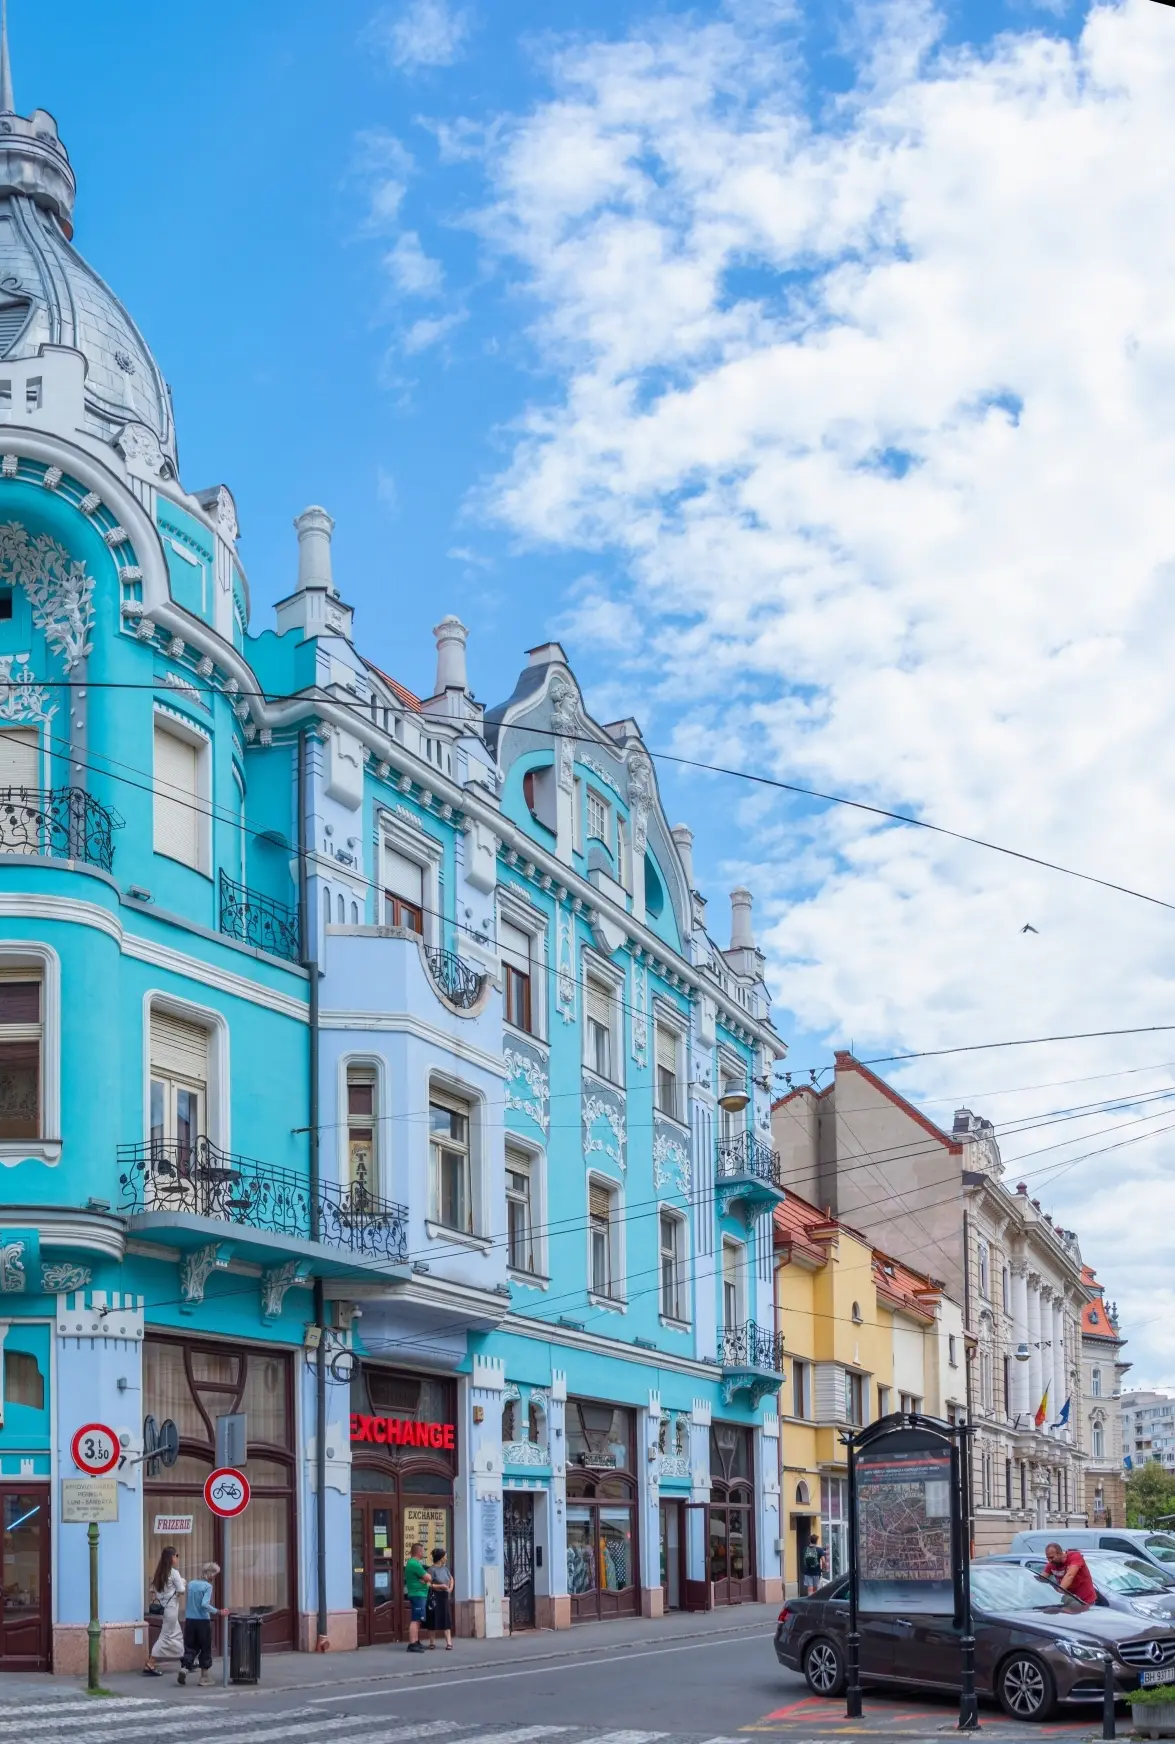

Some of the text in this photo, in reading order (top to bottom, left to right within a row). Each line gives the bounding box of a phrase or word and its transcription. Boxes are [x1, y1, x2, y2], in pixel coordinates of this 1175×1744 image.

[349, 1412, 455, 1449] EXCHANGE
[407, 1510, 443, 1521] EXCHANGE
[156, 1518, 192, 1530] FRIZERIE
[1144, 1672, 1155, 1683] BH
